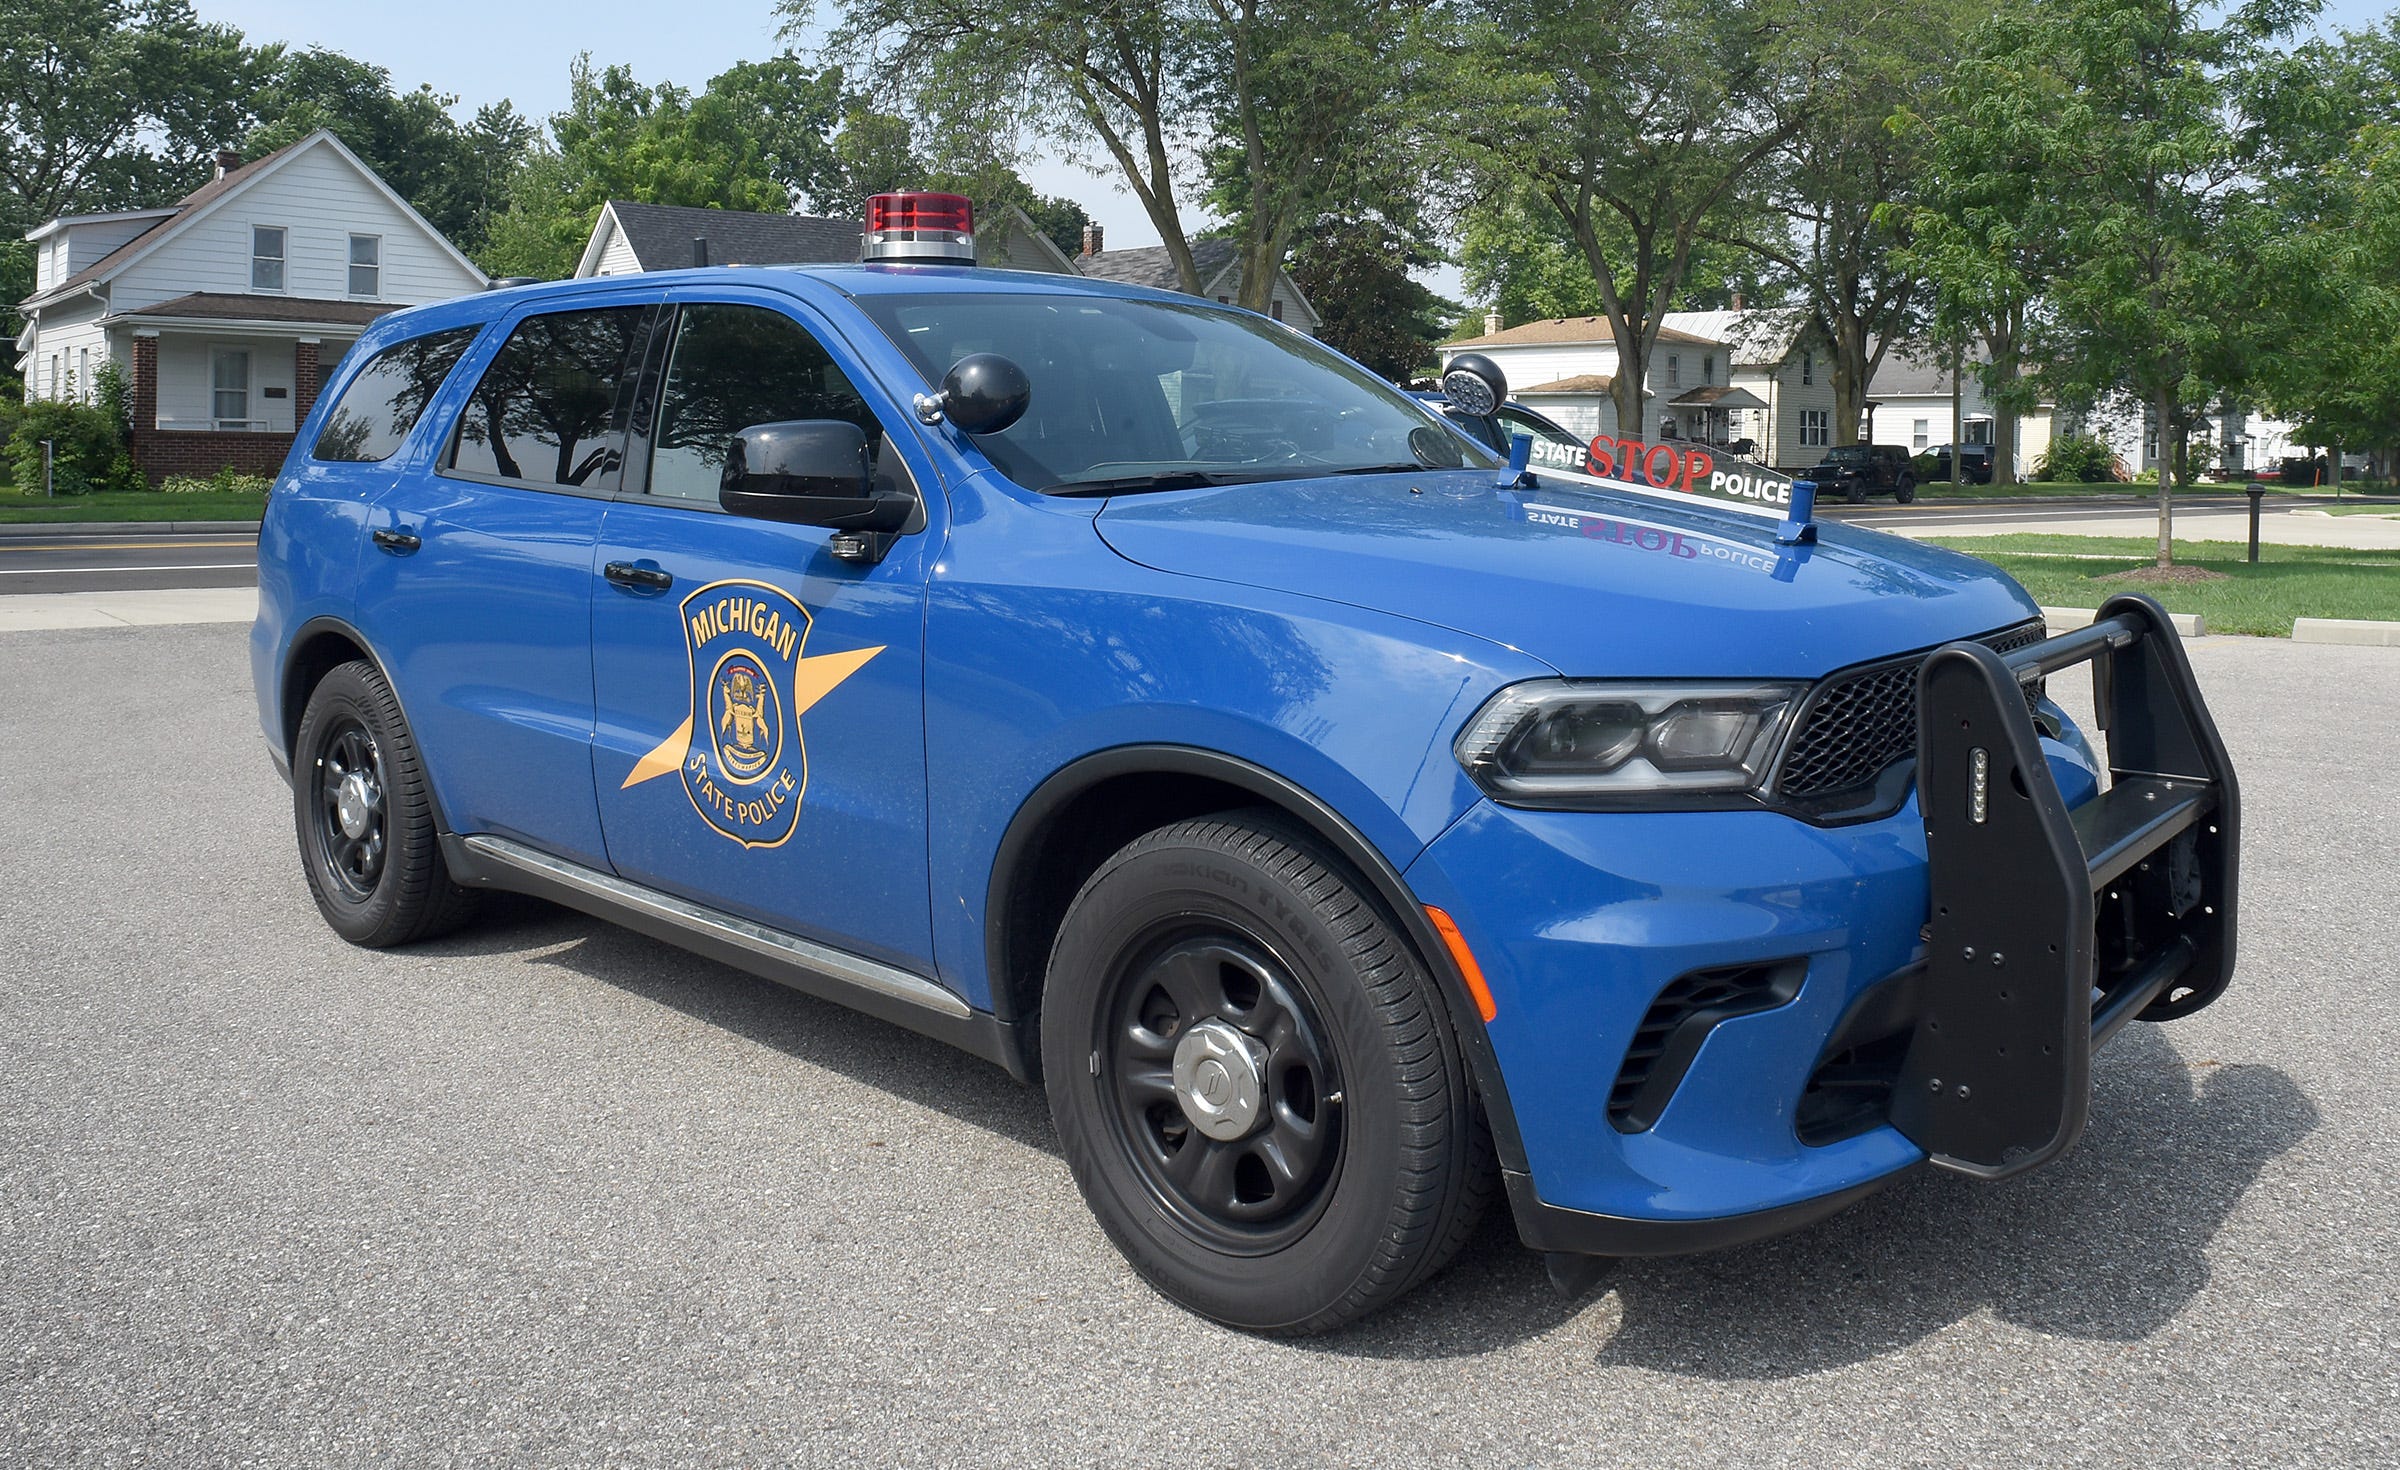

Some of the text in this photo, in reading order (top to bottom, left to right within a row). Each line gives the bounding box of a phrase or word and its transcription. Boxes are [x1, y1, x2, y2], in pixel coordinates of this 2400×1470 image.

[1532, 434, 1791, 505] STATE STOP POLICE
[691, 597, 797, 662] MICHIGAN
[690, 752, 797, 825] STATE POLICE
[1258, 887, 1336, 974] TYRES
